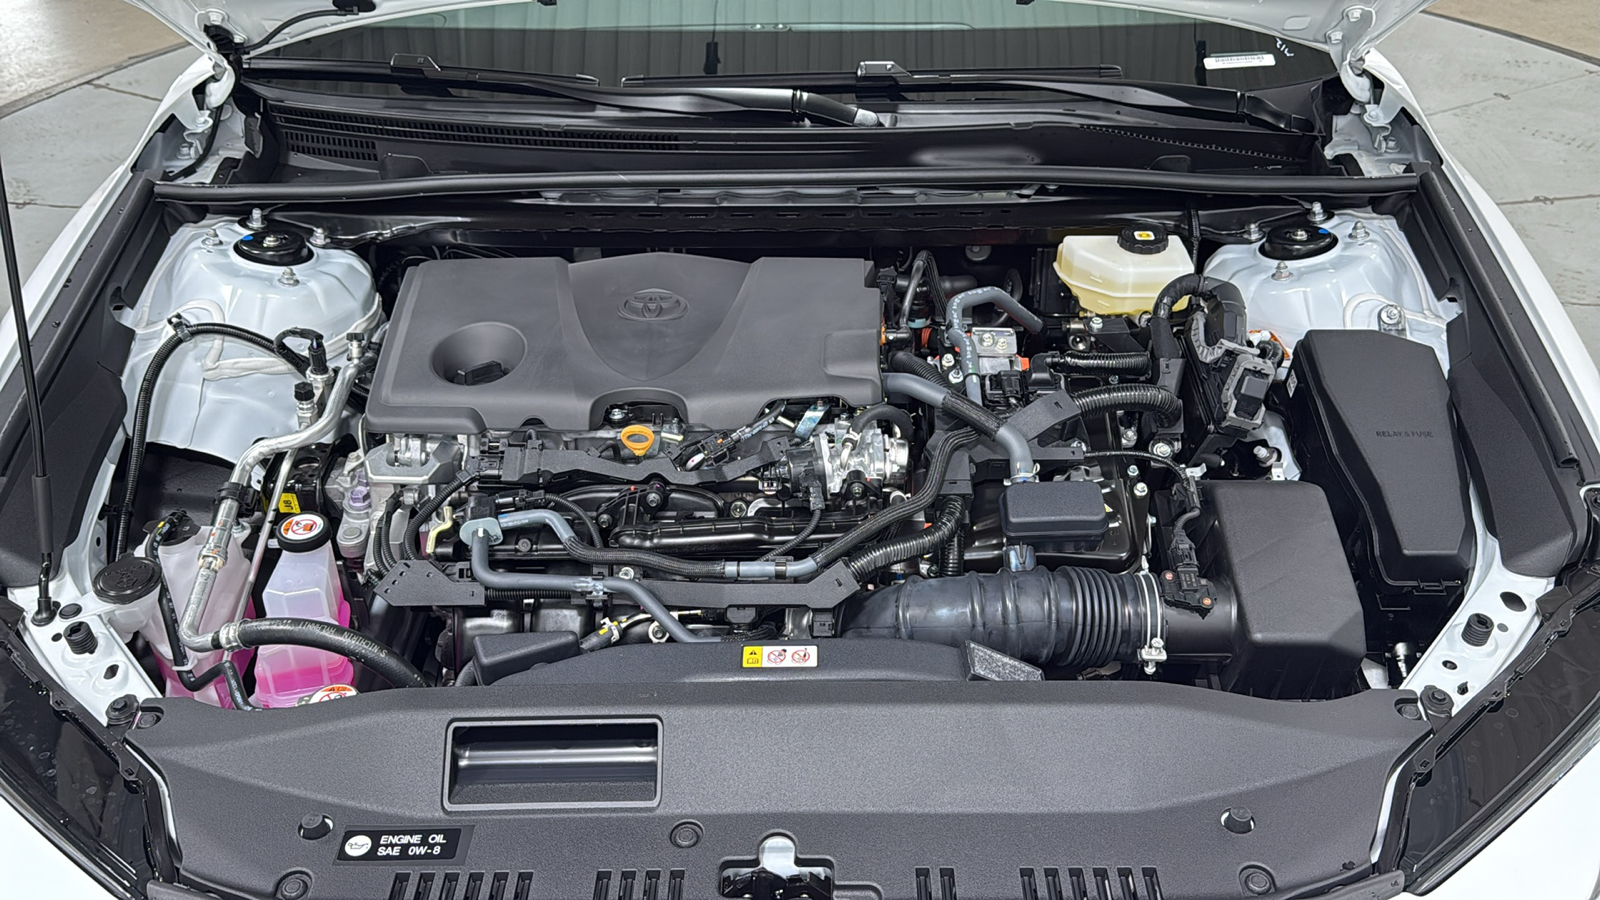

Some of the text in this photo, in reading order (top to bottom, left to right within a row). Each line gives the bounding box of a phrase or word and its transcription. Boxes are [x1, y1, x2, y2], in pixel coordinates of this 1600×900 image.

[1375, 430, 1402, 438] RELAY
[1411, 430, 1434, 438] FUSE
[379, 833, 447, 845] ENGINE OIL
[376, 845, 441, 856] SAE 0W-8
